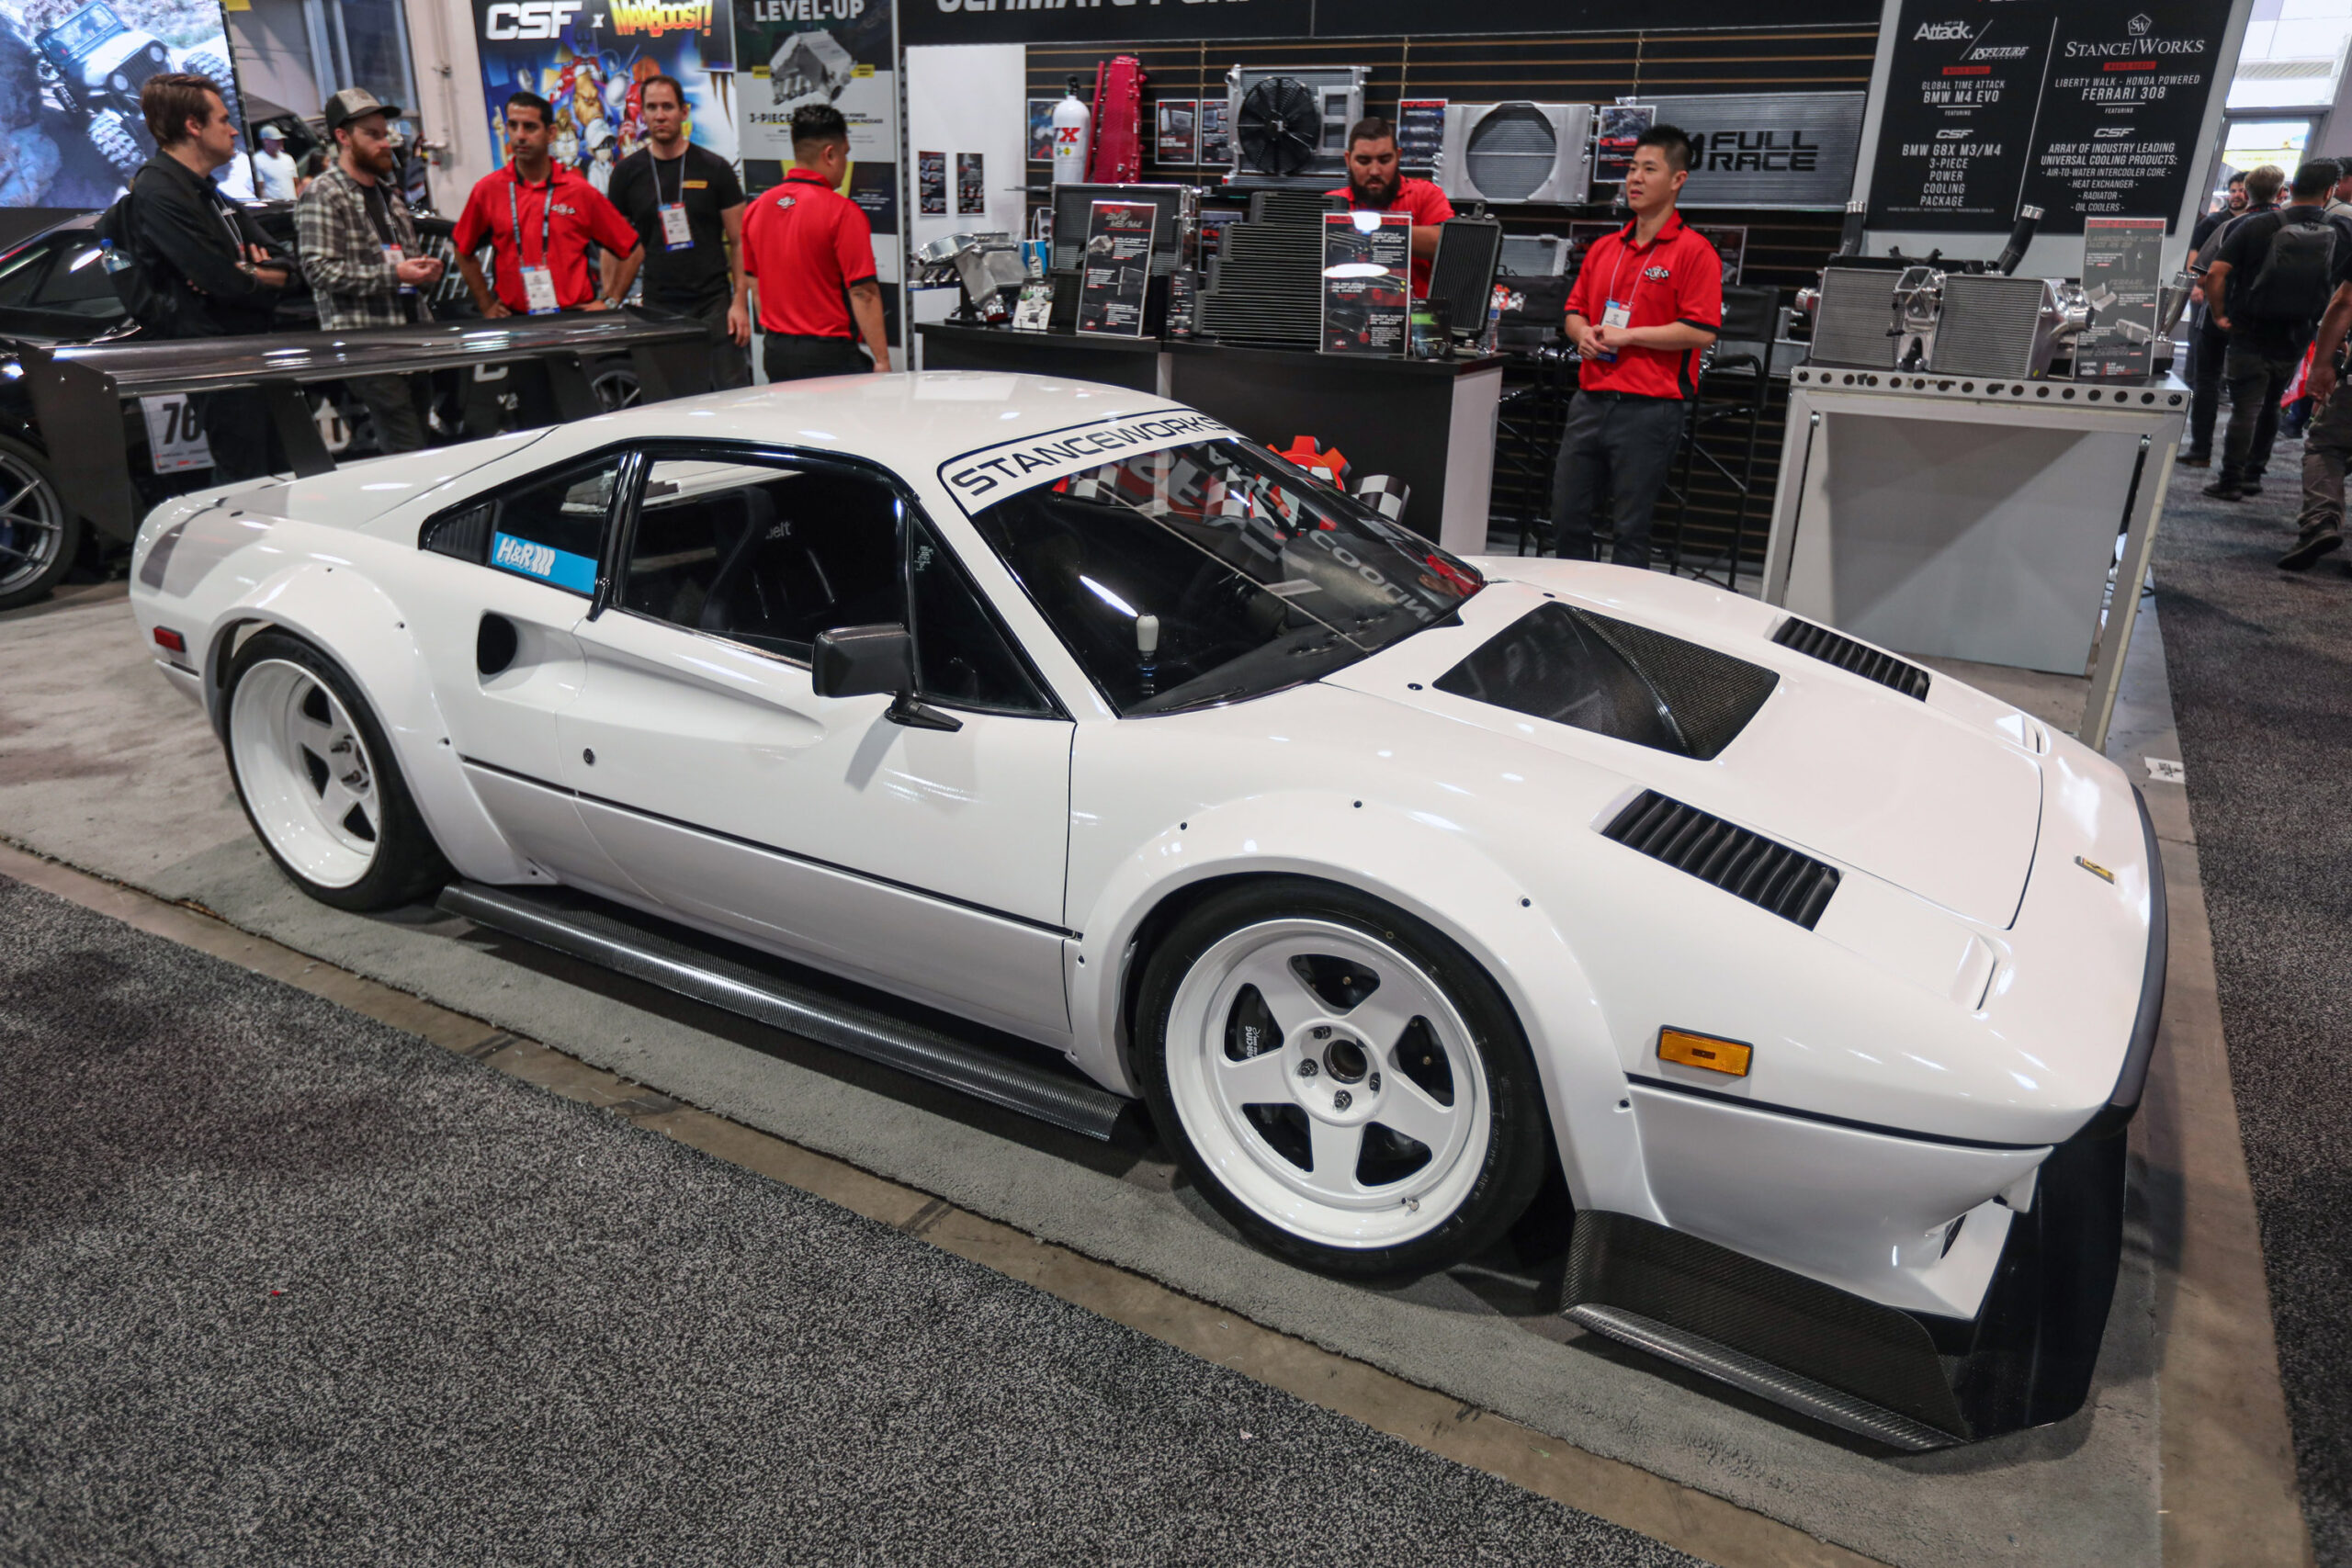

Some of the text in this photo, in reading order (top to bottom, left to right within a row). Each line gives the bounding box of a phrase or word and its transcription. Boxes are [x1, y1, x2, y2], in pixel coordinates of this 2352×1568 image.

[754, 0, 865, 22] LEVEL-UP
[486, 1, 582, 40] CSF
[1922, 80, 2006, 91] GLOBAL TIME ATTACK
[2055, 78, 2090, 88] LIBERTY
[2093, 77, 2117, 86] WALK
[2126, 76, 2155, 85] HONDA
[2157, 74, 2200, 85] POWERED
[1923, 90, 2000, 104] BMW M4 EVO
[2082, 86, 2166, 101] FERRARI 308
[1936, 130, 1974, 139] CSF
[2094, 128, 2135, 138] CSF
[1710, 130, 1819, 151] FULL
[1902, 143, 2002, 158] BMW G8X M3/M4
[2048, 142, 2176, 154] ARRAY OF INDUSTRY LEADING
[1708, 152, 1818, 172] RACE
[1929, 158, 1969, 169] 3-PIECE
[2041, 154, 2178, 165] UNIVERSAL COOLING PRODUCTS:
[1929, 171, 1963, 182] POWER
[2046, 167, 2166, 177] AIR-TO-WATER INTERCOOLER CORE
[1923, 183, 1966, 194] COOLING
[2072, 179, 2134, 189] HEAT EXCHANGER
[2083, 191, 2118, 200] RADIATOR
[1920, 196, 1964, 207] PACKAGE
[2075, 202, 2120, 212] OIL COOLERS
[951, 416, 1229, 496] STANCEWORKS
[496, 536, 535, 571] H&R
